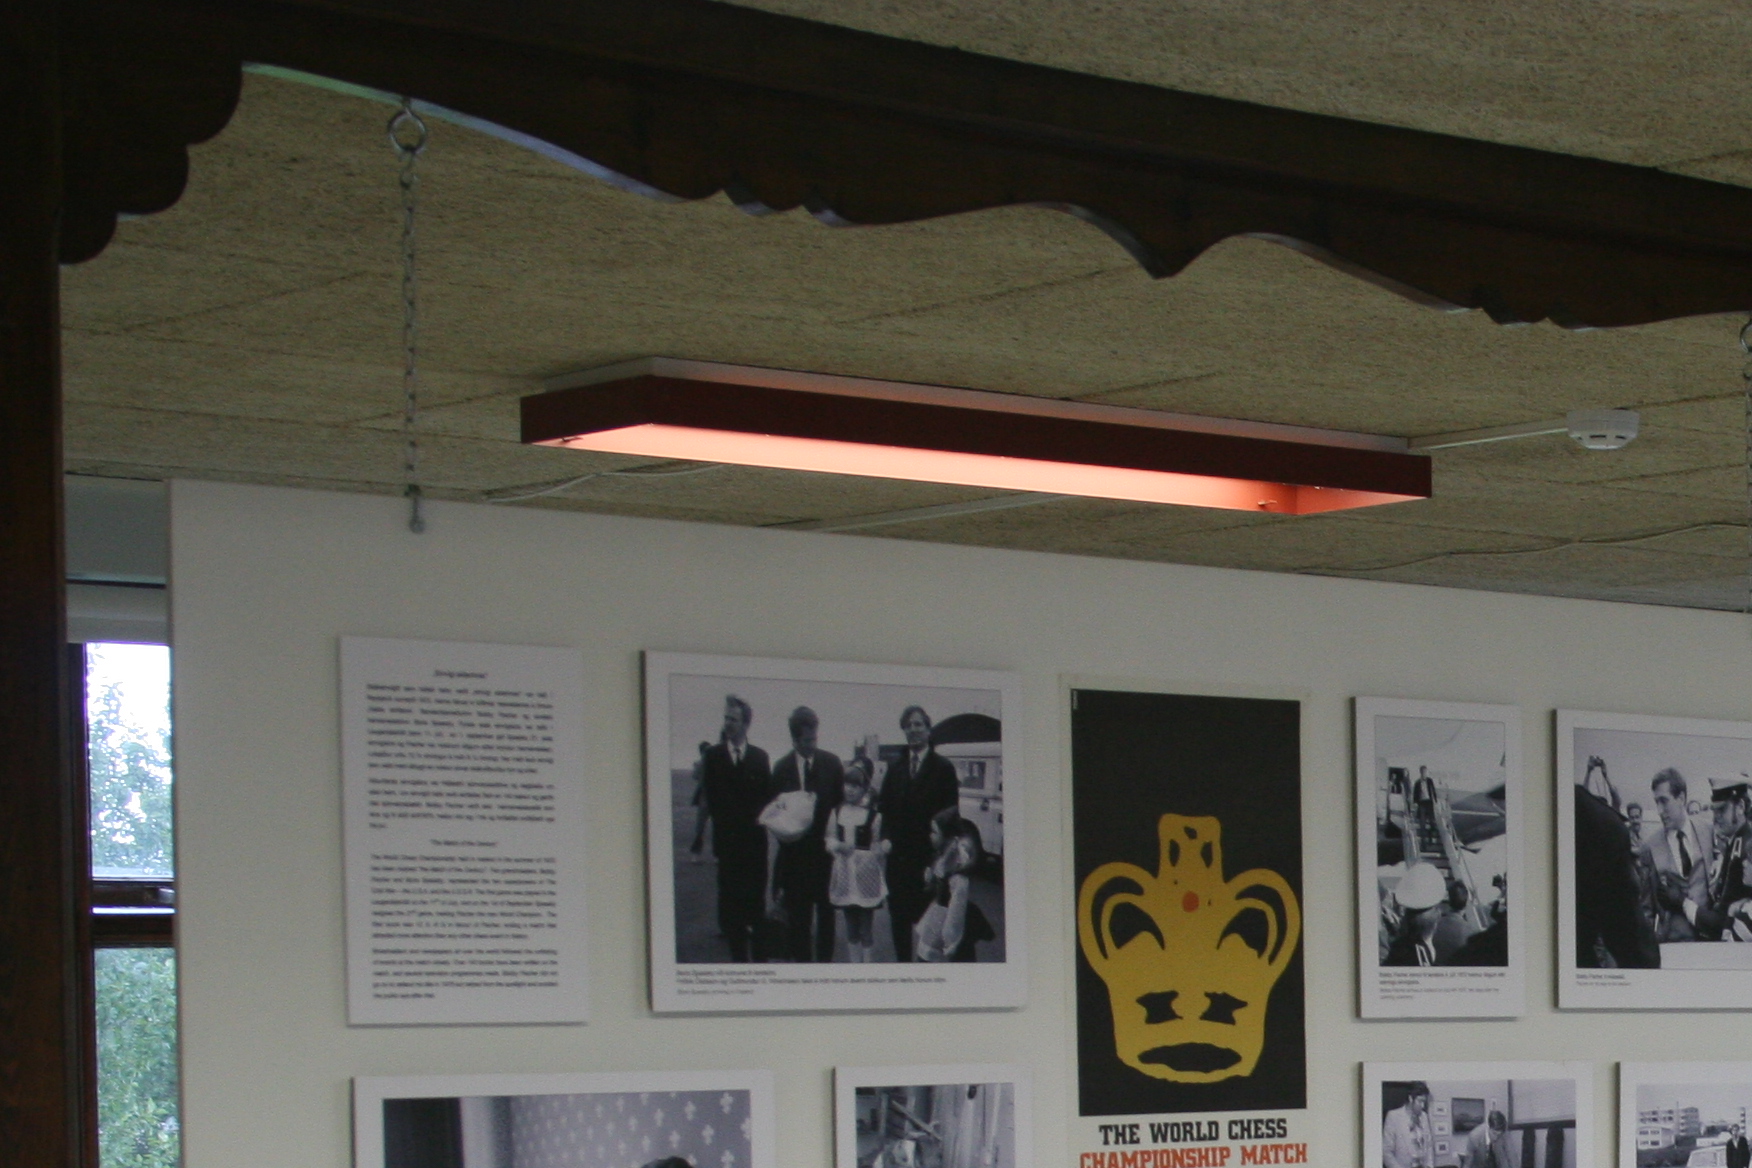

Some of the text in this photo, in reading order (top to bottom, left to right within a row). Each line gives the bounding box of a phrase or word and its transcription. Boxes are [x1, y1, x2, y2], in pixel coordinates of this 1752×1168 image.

[1098, 1117, 1288, 1146] THE WORLD CHESS
[1240, 1142, 1308, 1166] MATCH
